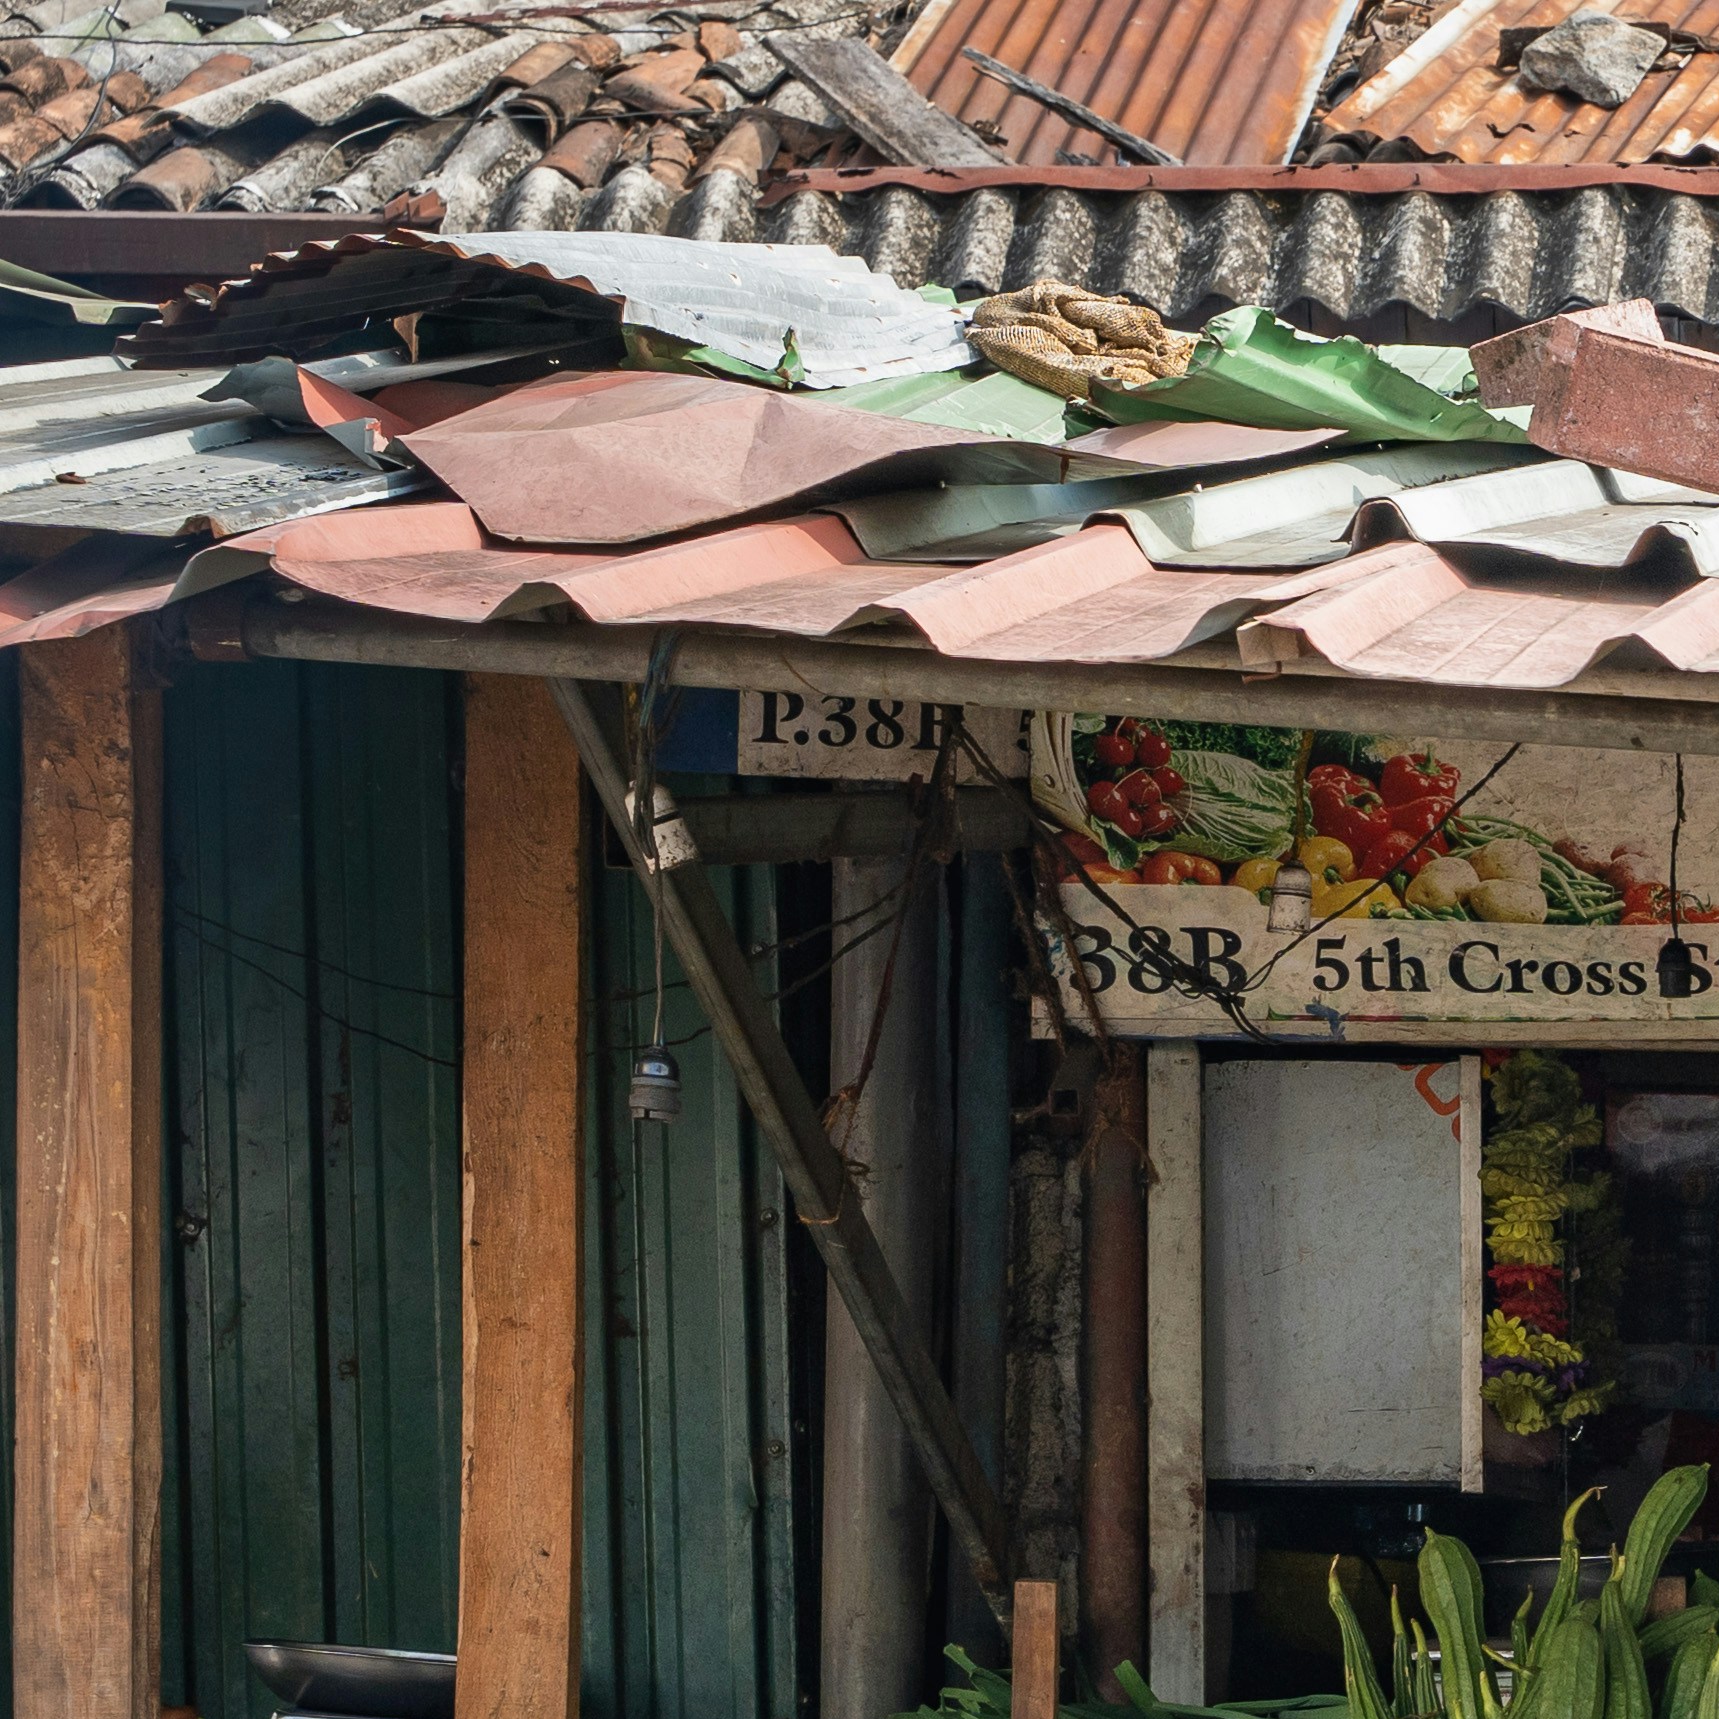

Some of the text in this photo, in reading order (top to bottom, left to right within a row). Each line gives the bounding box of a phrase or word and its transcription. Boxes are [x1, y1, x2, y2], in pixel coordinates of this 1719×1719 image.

[1070, 925, 1248, 994] 38B
[1312, 938, 1431, 993] 5th
[1448, 941, 1647, 996] Cross
